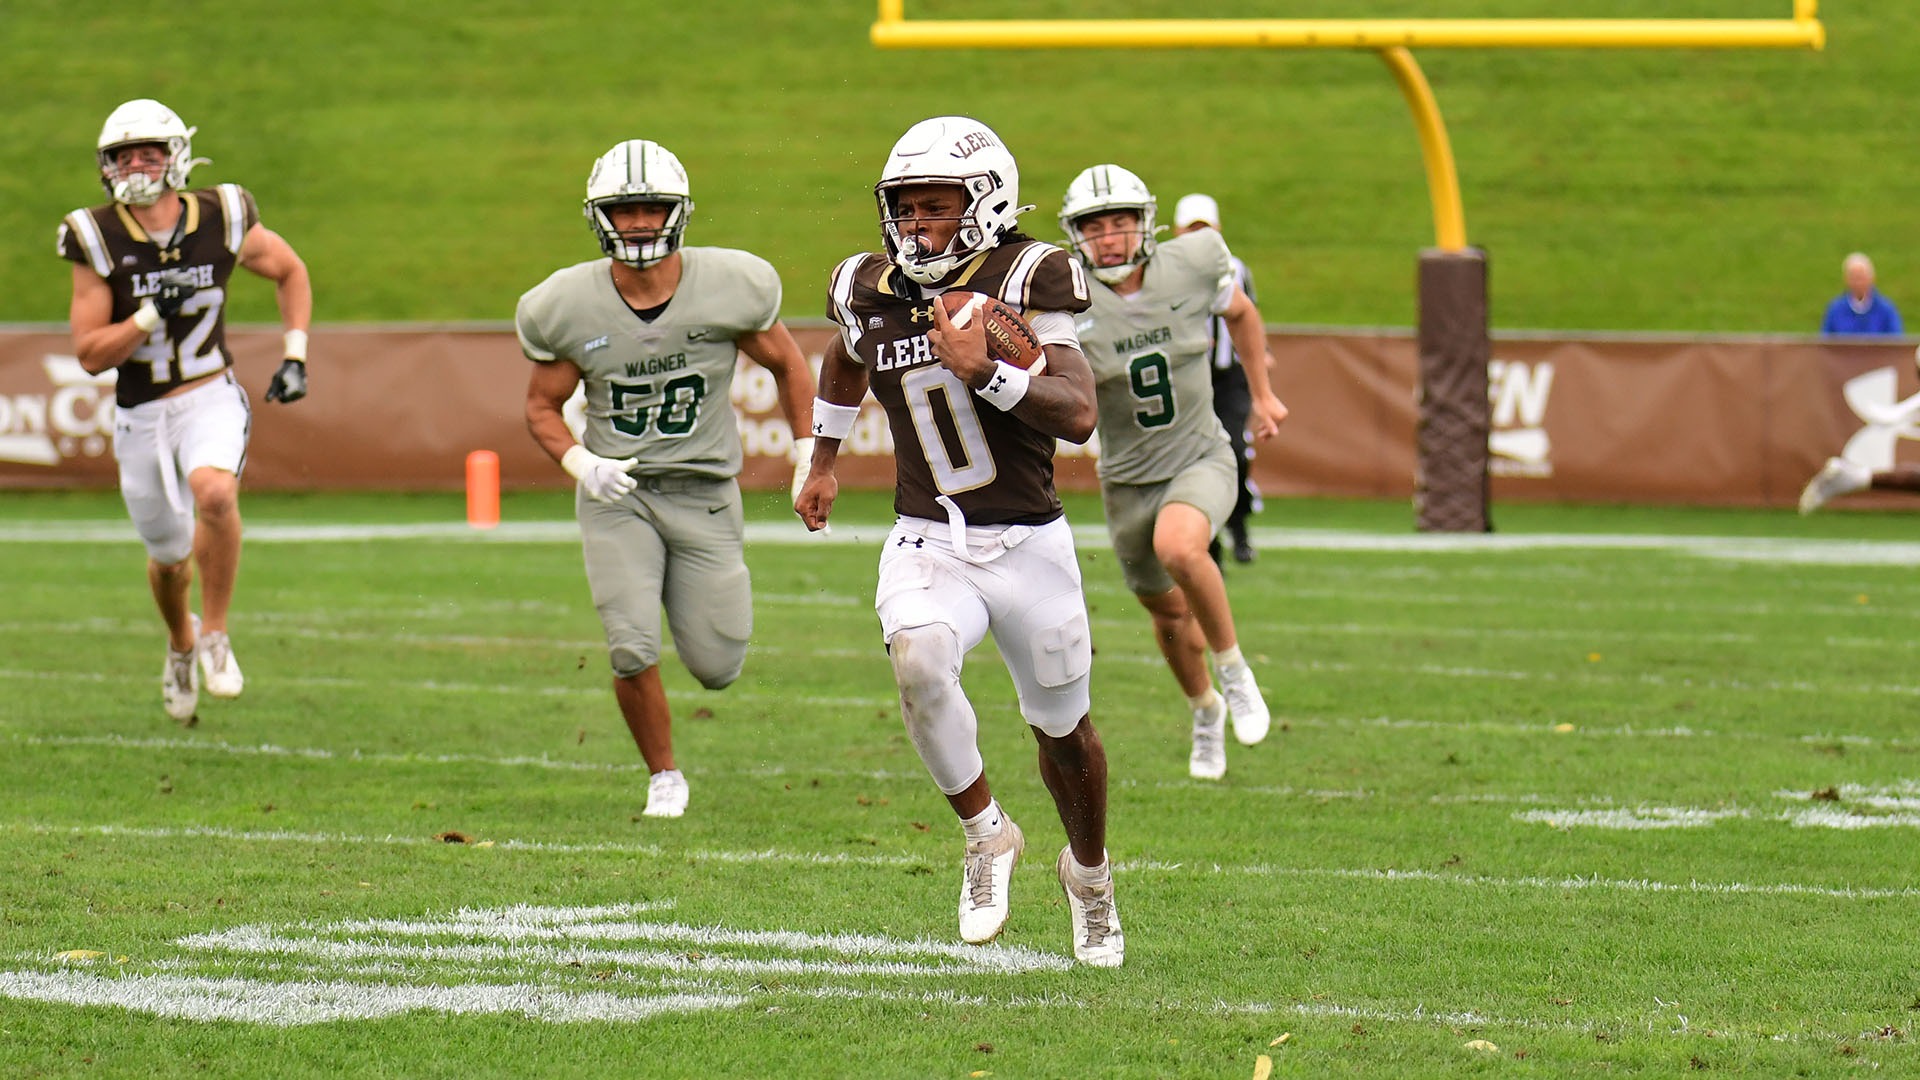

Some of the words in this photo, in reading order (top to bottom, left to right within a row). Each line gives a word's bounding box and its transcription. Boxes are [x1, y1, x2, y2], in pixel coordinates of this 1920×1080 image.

[954, 131, 1000, 160] LEH
[131, 264, 215, 298] LEGH
[1068, 257, 1088, 301] 0
[127, 286, 227, 384] 42
[876, 333, 937, 372] LEH
[986, 318, 1022, 359] Wilson
[1113, 326, 1173, 354] WAGNER
[624, 352, 688, 378] WAGNER
[606, 370, 708, 438] 50
[1124, 348, 1179, 432] 9
[900, 360, 997, 496] 0
